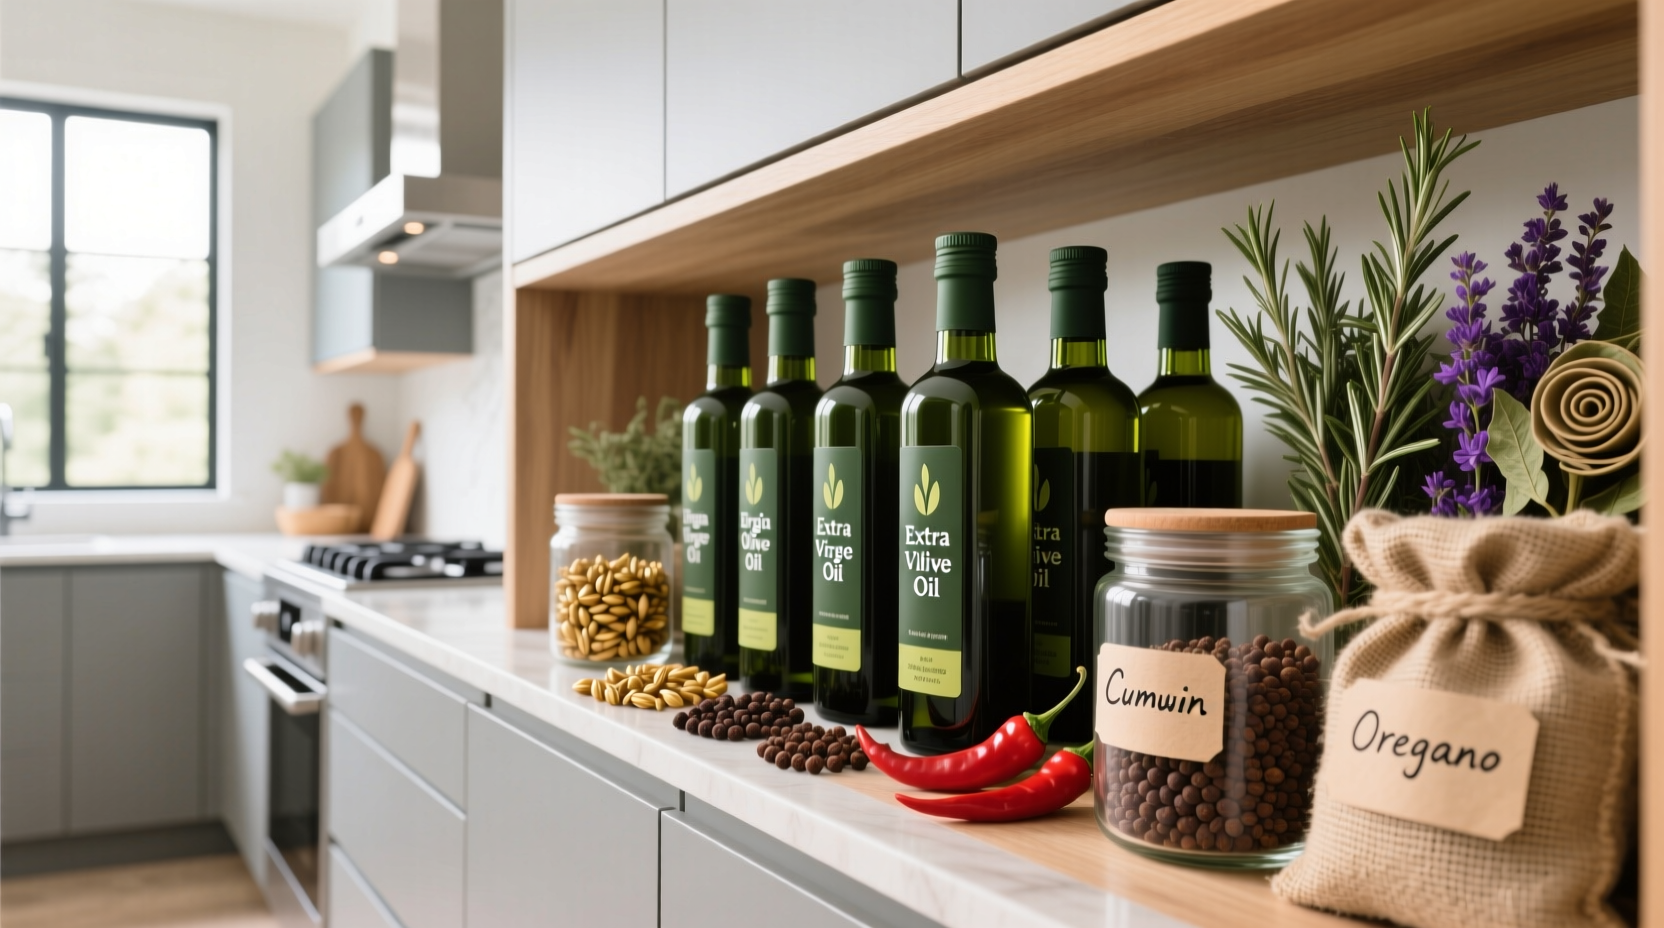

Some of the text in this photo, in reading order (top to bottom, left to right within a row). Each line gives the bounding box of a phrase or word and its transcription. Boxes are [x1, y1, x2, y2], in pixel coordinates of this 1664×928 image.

[816, 517, 852, 537] Extra
[905, 525, 950, 546] Extra
[1033, 523, 1061, 541] tra
[745, 552, 763, 571] Oil
[1033, 546, 1062, 565] ive
[823, 562, 843, 582] Oil
[913, 576, 940, 597] Oil
[1105, 668, 1208, 716] Cumwin
[1351, 710, 1501, 779] Oregano
